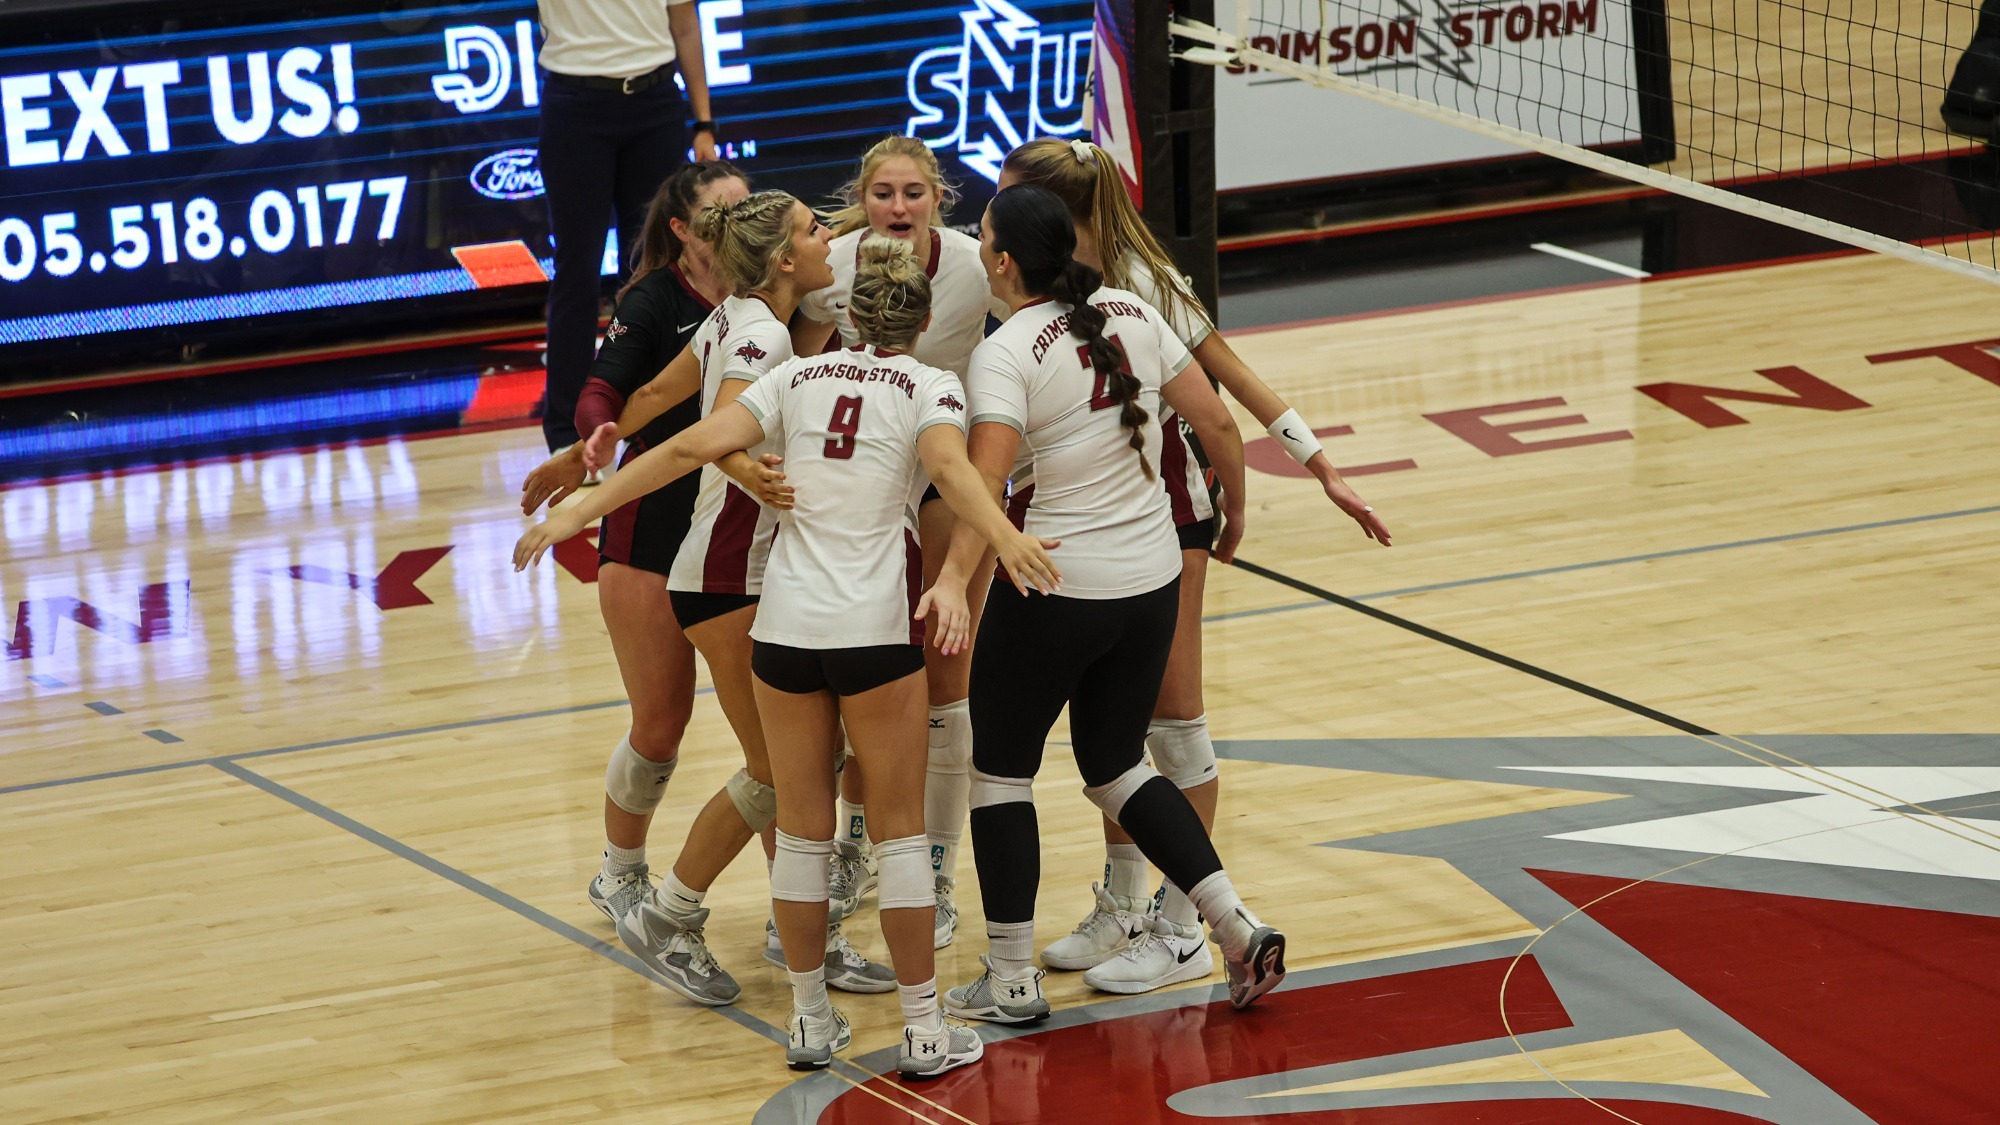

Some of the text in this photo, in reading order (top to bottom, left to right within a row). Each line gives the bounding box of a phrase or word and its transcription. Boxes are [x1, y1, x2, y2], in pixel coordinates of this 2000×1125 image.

[1451, 0, 1599, 49] STORM
[0, 43, 360, 167] EXT US!
[0, 176, 408, 282] 05.518.0177
[1095, 301, 1149, 323] TORM
[790, 362, 916, 400] CRIMSON STORM
[823, 394, 864, 461] 9
